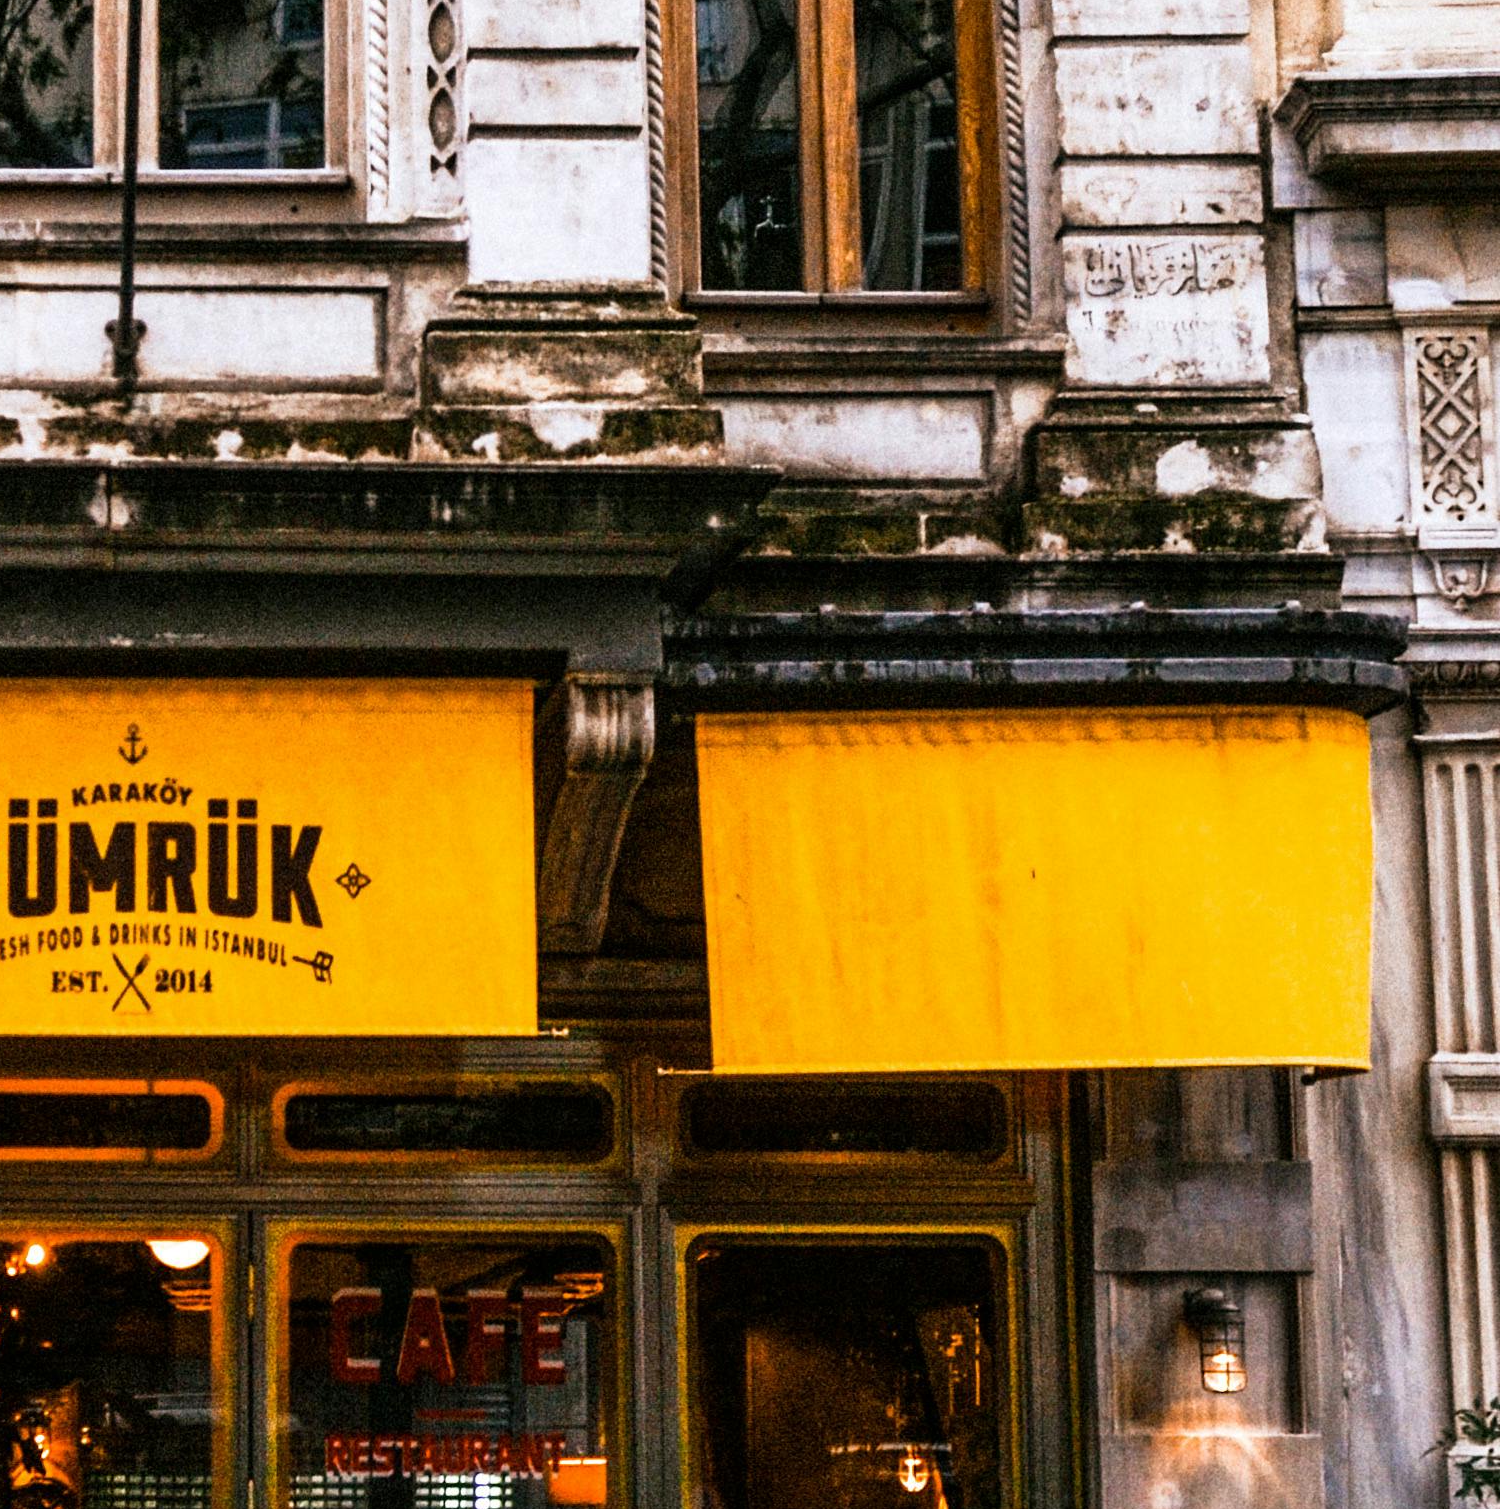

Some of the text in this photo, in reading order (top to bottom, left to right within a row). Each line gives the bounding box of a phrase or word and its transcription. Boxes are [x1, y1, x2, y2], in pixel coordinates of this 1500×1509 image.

[72, 777, 193, 807] KARAKÖY
[37, 925, 83, 953] FOOD
[91, 925, 101, 946] &
[109, 922, 172, 947] DRINKS
[179, 925, 198, 949] IN
[204, 927, 288, 967] ISTANBUL
[51, 968, 214, 993] EST. 2014
[329, 1286, 568, 1386] CAFE
[324, 1432, 568, 1480] RESTAURANT
